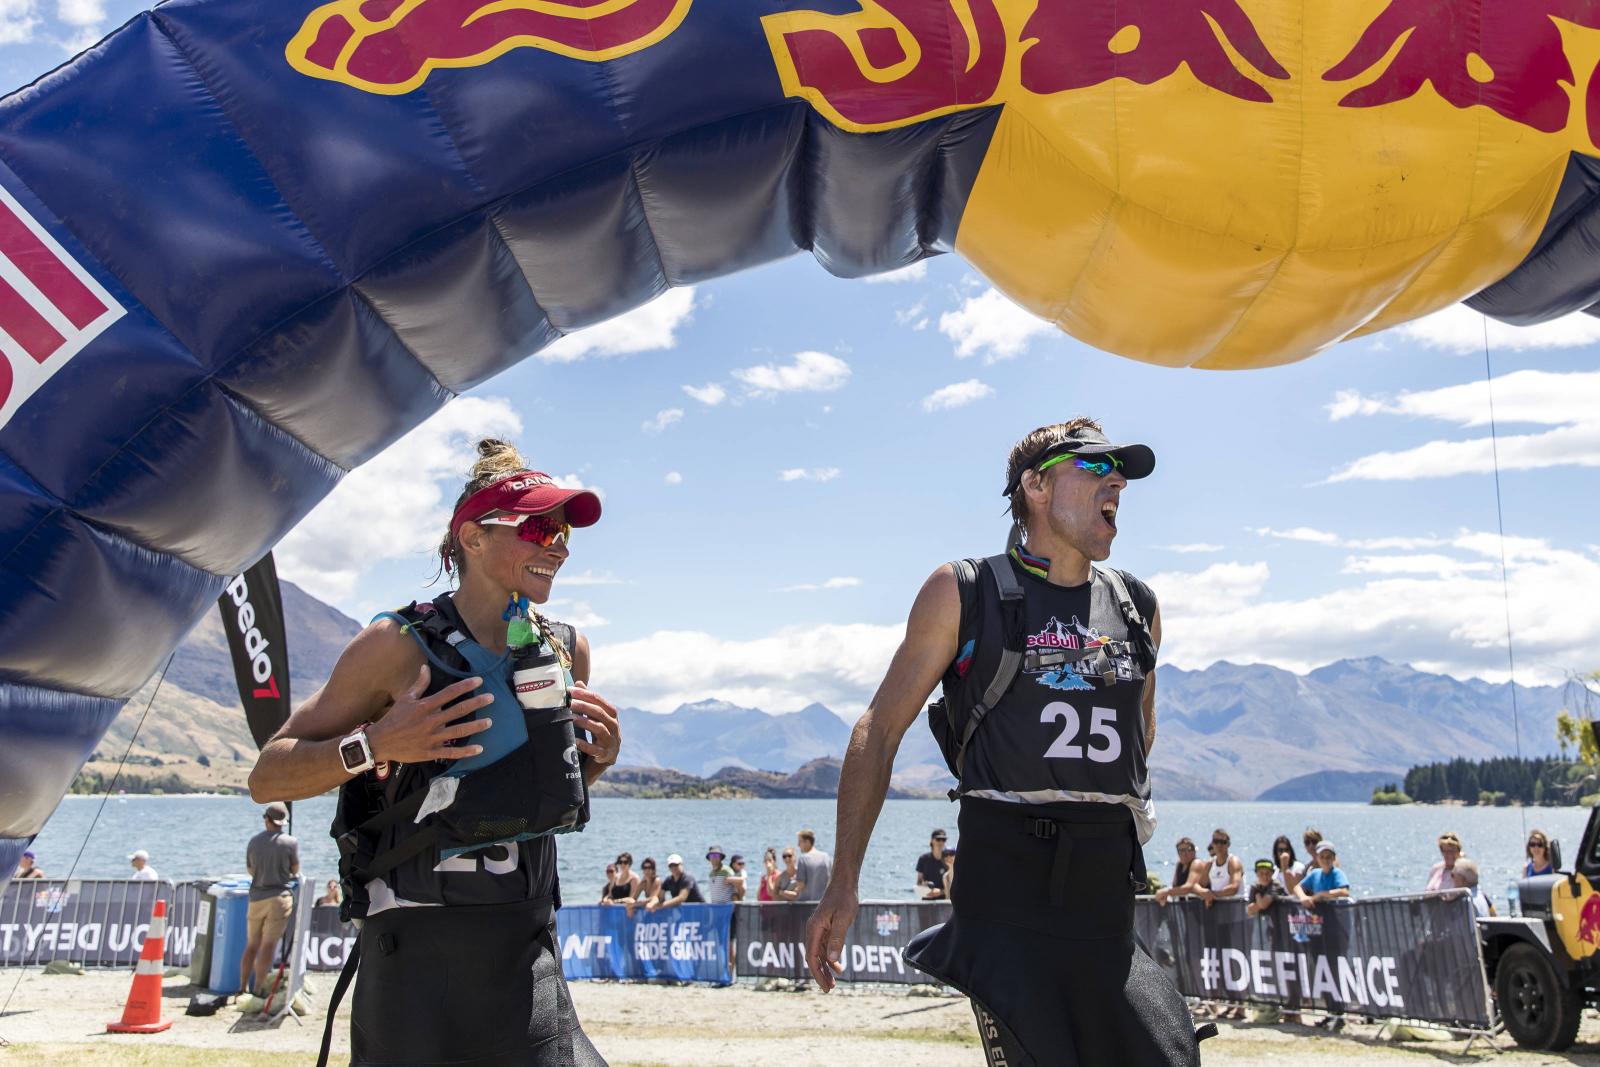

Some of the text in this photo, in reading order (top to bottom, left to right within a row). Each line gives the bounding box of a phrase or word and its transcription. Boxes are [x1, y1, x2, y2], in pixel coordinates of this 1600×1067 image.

[1040, 701, 1122, 763] 25
[635, 921, 703, 941] RIDE LIFE.
[635, 940, 717, 960] RIDE GIANT.
[747, 941, 795, 969] CAN
[852, 944, 905, 974] DEFY
[1200, 947, 1404, 1008] #DEFIANCE
